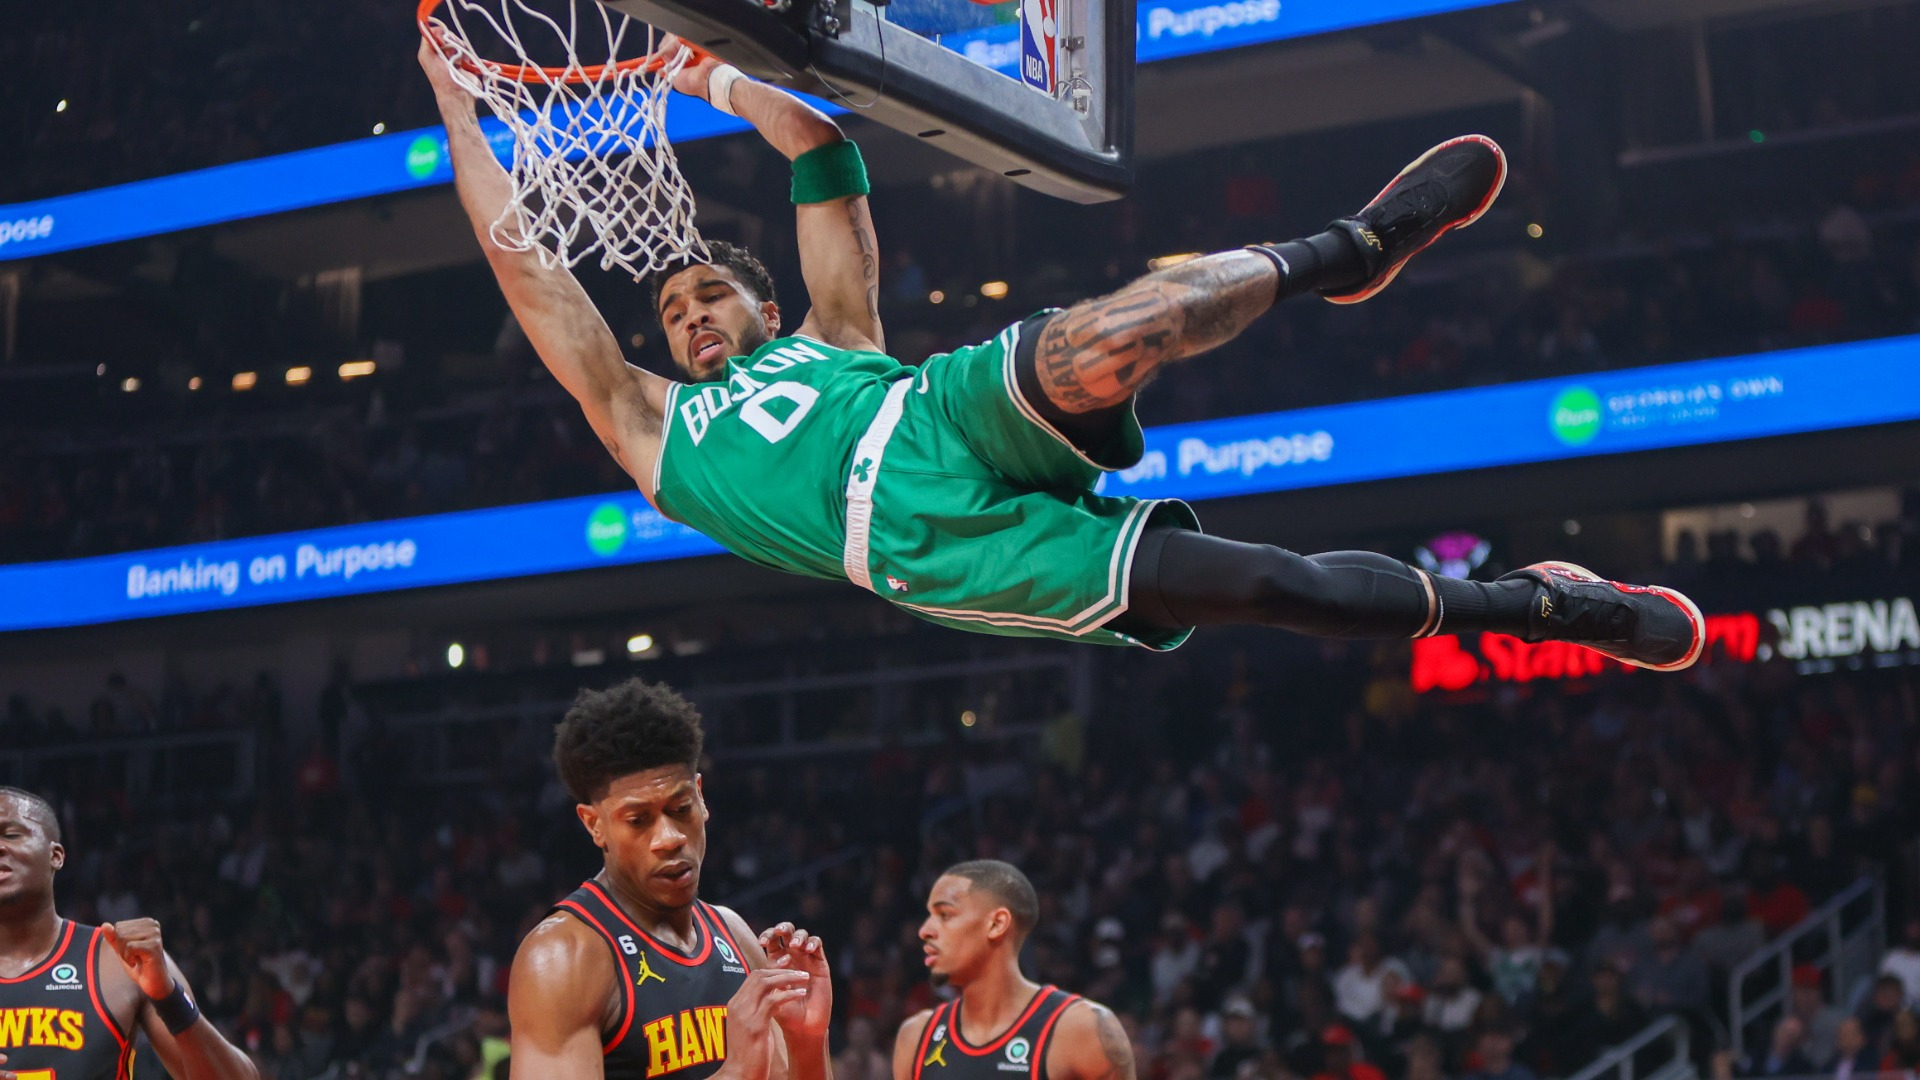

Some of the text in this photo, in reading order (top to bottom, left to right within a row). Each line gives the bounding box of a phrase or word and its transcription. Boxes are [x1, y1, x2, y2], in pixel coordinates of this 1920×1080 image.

[1148, 0, 1281, 38] Purpose
[1025, 54, 1044, 84] NBA
[739, 381, 821, 445] 0
[1119, 451, 1167, 483] on
[1177, 430, 1334, 476] Purpose
[127, 539, 416, 599] Banking on Purpose
[618, 934, 639, 956] 6
[643, 1005, 728, 1079] HAW
